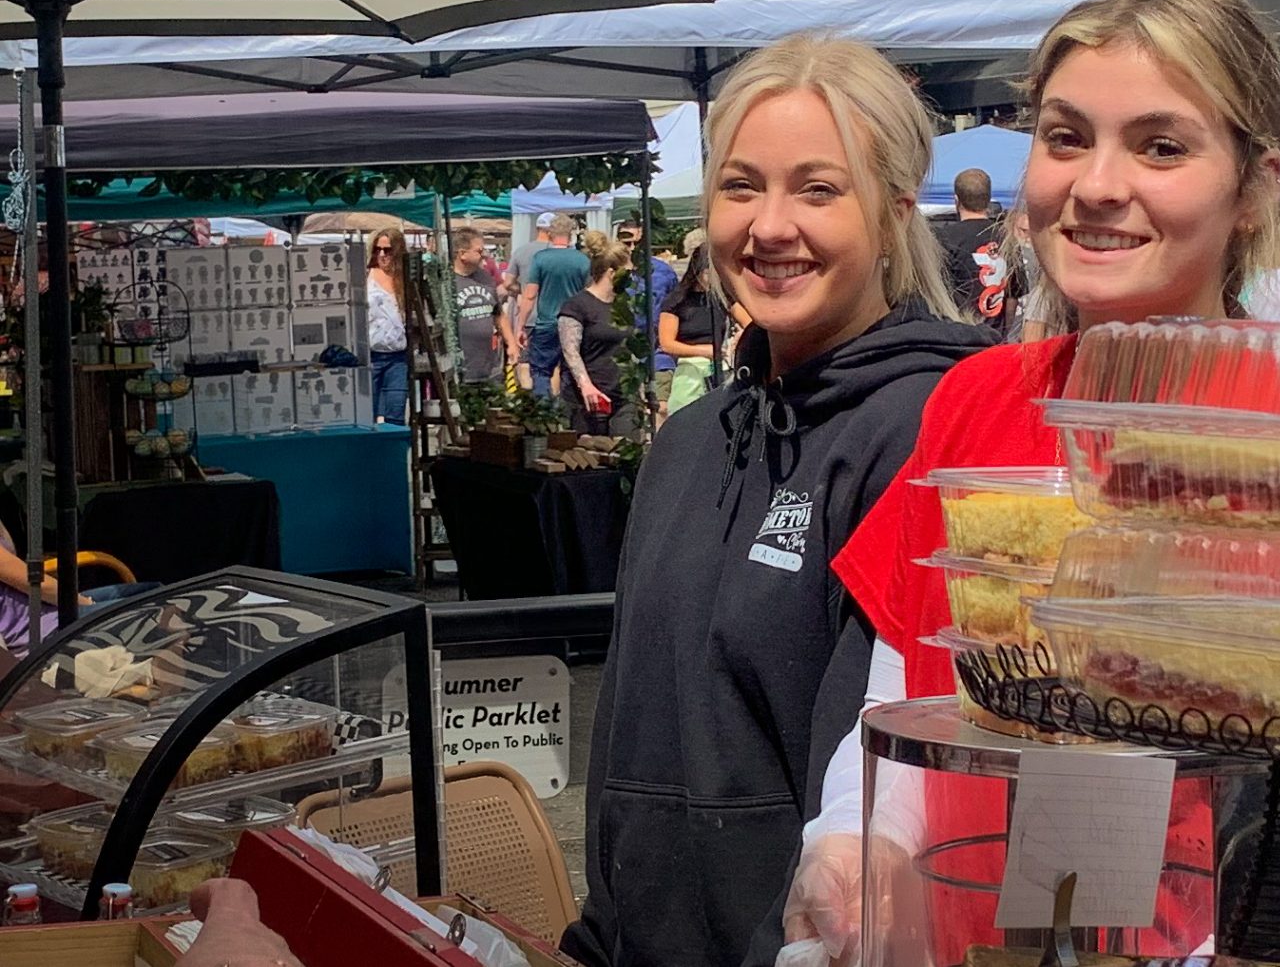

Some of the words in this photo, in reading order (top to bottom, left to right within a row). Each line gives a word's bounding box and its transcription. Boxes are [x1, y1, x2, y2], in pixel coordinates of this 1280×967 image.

[442, 676, 524, 696] umner
[472, 701, 562, 728] Parklet
[462, 737, 500, 754] Open
[503, 735, 519, 749] To
[523, 732, 564, 748] Public
